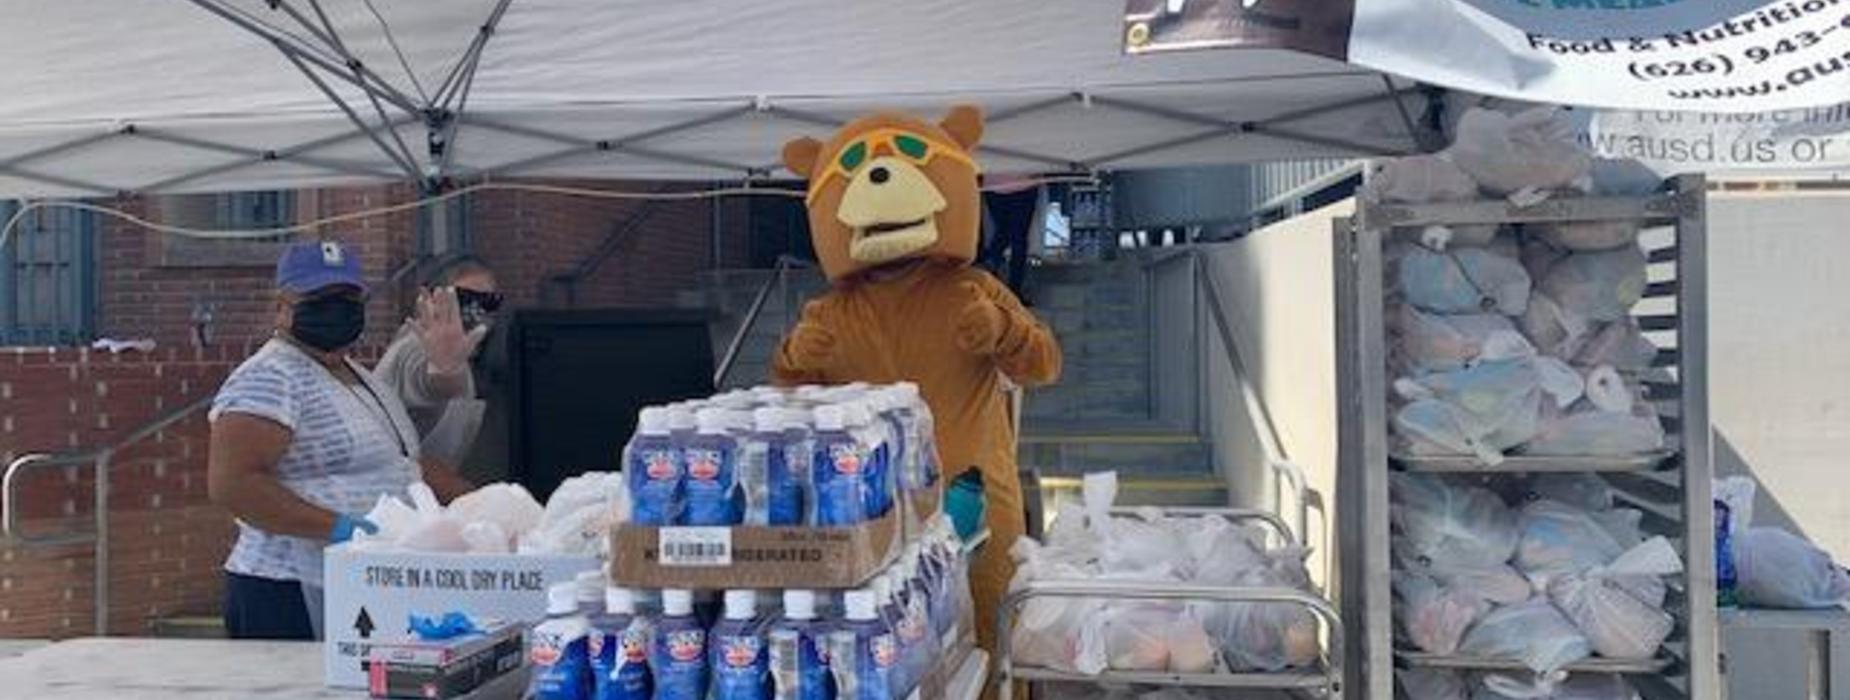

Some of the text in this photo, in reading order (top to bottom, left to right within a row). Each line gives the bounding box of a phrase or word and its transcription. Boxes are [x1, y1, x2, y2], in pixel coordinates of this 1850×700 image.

[1526, 0, 1839, 55] Food & Nutritio
[1628, 53, 1734, 80] (626)
[1791, 137, 1832, 161] or
[366, 566, 544, 591] STORE IN A COOL DRY PLACE
